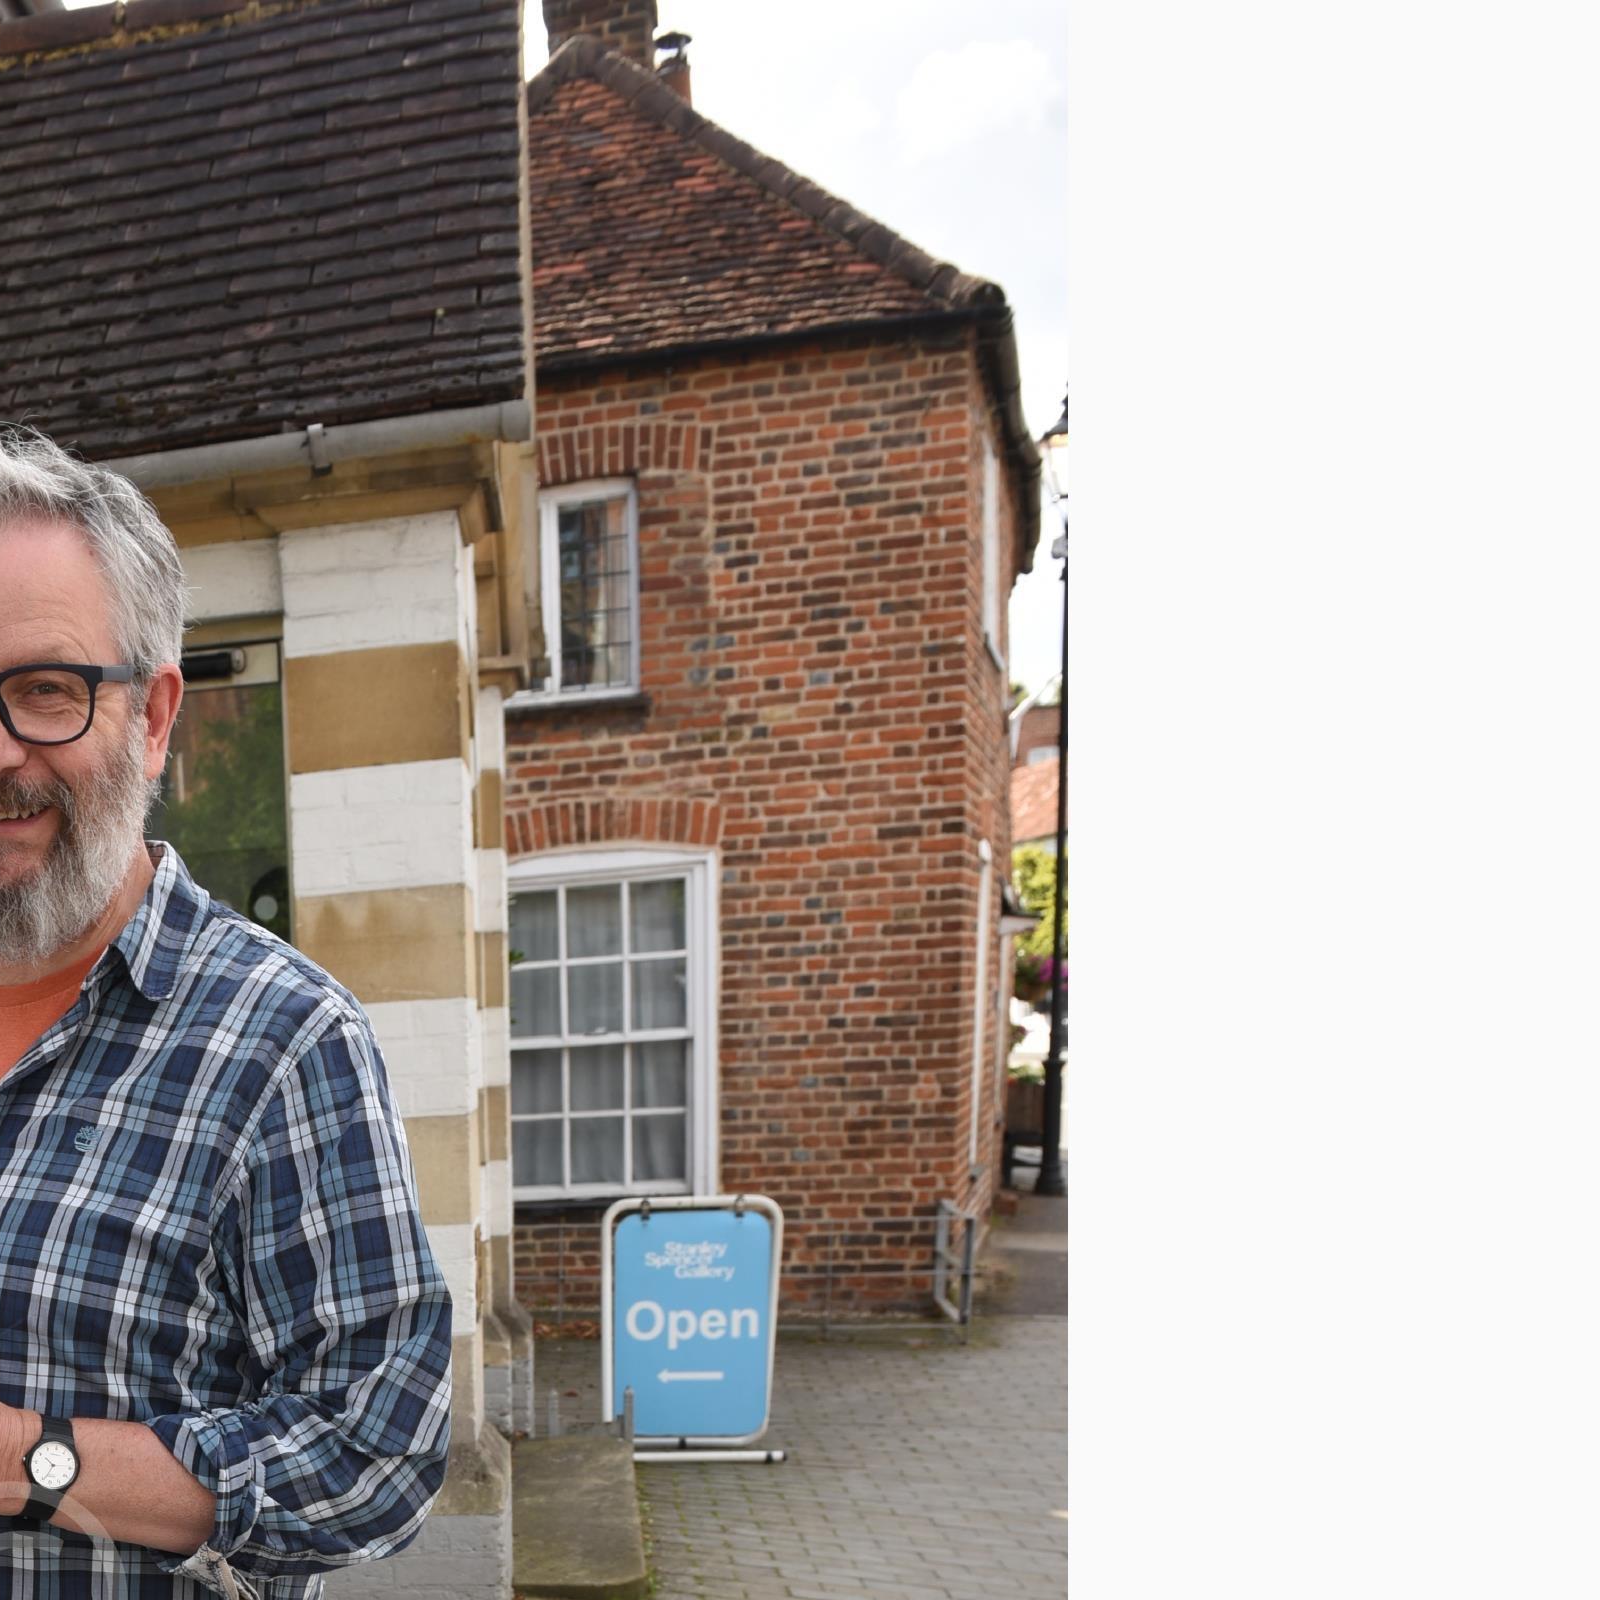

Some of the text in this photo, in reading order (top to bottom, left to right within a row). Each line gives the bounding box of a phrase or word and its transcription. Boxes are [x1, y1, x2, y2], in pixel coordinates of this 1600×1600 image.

[664, 1241, 728, 1259] Stanley
[644, 1252, 713, 1270] Spencer
[674, 1265, 736, 1282] Gallery
[626, 1300, 759, 1350] Open
